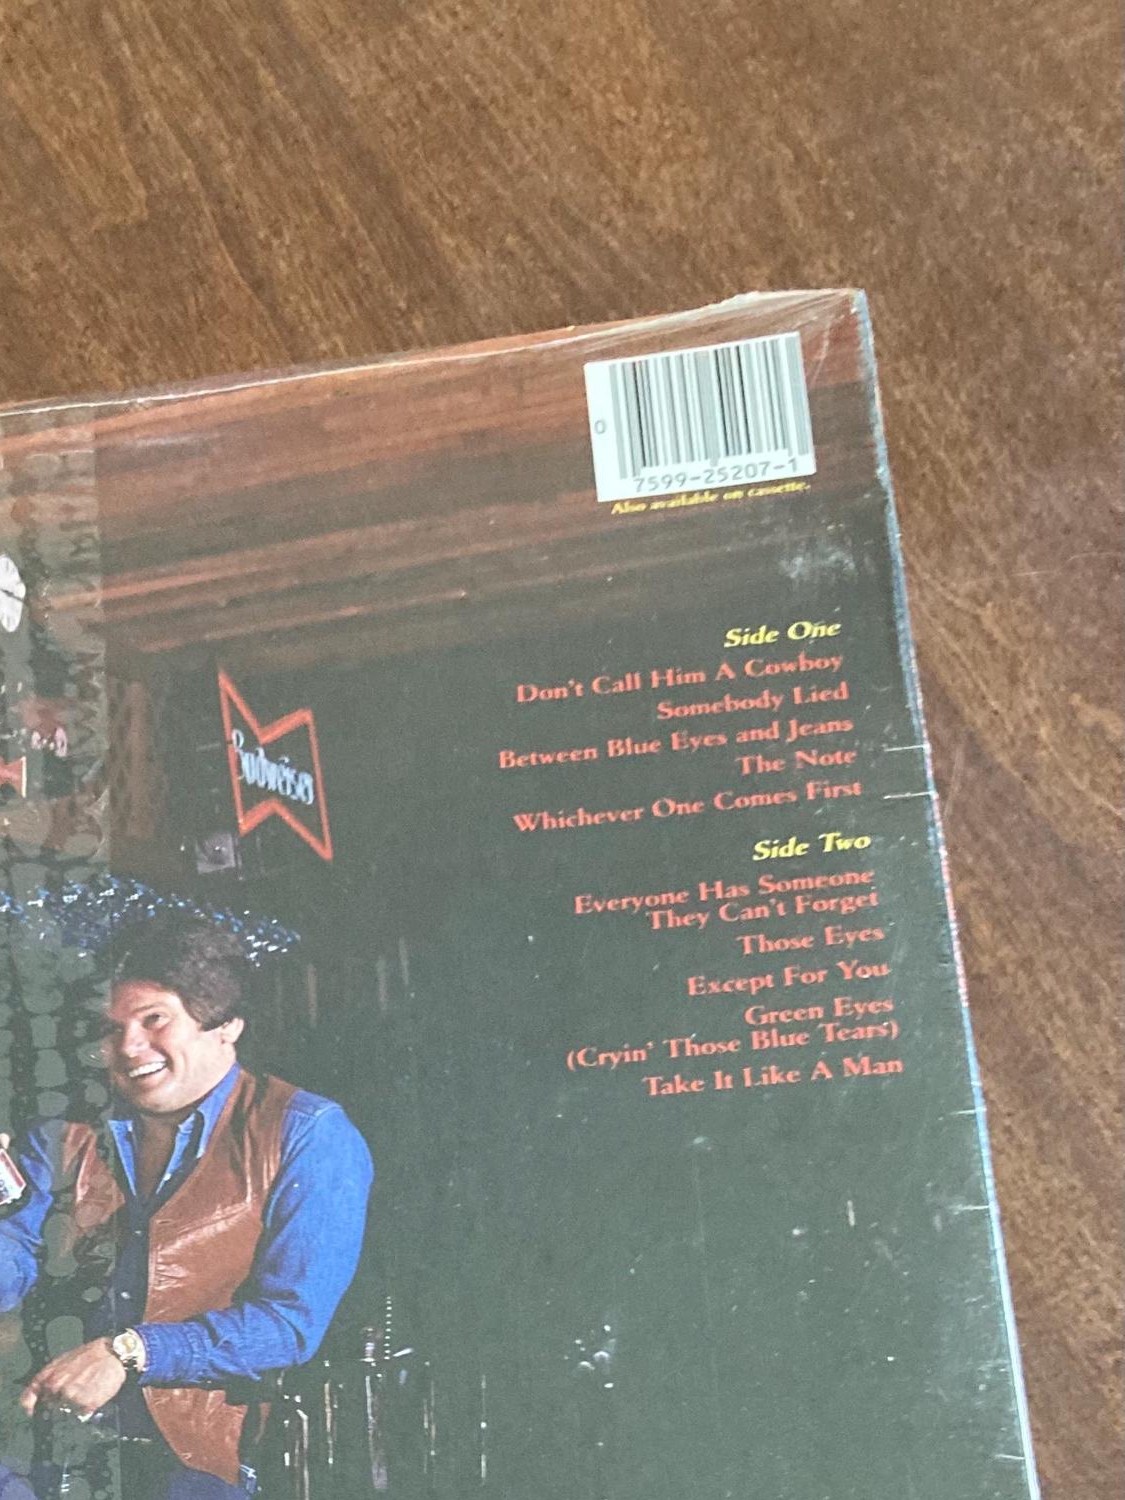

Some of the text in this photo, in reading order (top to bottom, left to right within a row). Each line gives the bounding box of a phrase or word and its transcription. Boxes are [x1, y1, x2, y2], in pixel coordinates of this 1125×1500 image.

[593, 420, 607, 435] 0
[632, 457, 799, 494] 7599-25207-1
[611, 501, 647, 515] Also
[649, 490, 719, 510] available
[723, 490, 744, 499] on
[723, 620, 843, 649] Side One
[516, 650, 844, 704] Don't Call Him A Cowboy
[656, 681, 851, 722] Somebody Lied
[497, 717, 855, 770] Between Blue Eyes and Jeans
[735, 747, 858, 777] The Note
[513, 779, 864, 833] Whichever One Comes First
[752, 832, 872, 862] Side Two
[574, 868, 876, 916] Everyone Has Someone
[646, 890, 879, 931] They Can't Forget
[736, 925, 886, 956] Those Eyes
[687, 960, 890, 998] Except For You
[744, 997, 895, 1027] Green Eyes
[566, 1021, 900, 1073] (Cryin' Those Blue Tears)
[643, 1055, 904, 1097] Take It Like A Man
